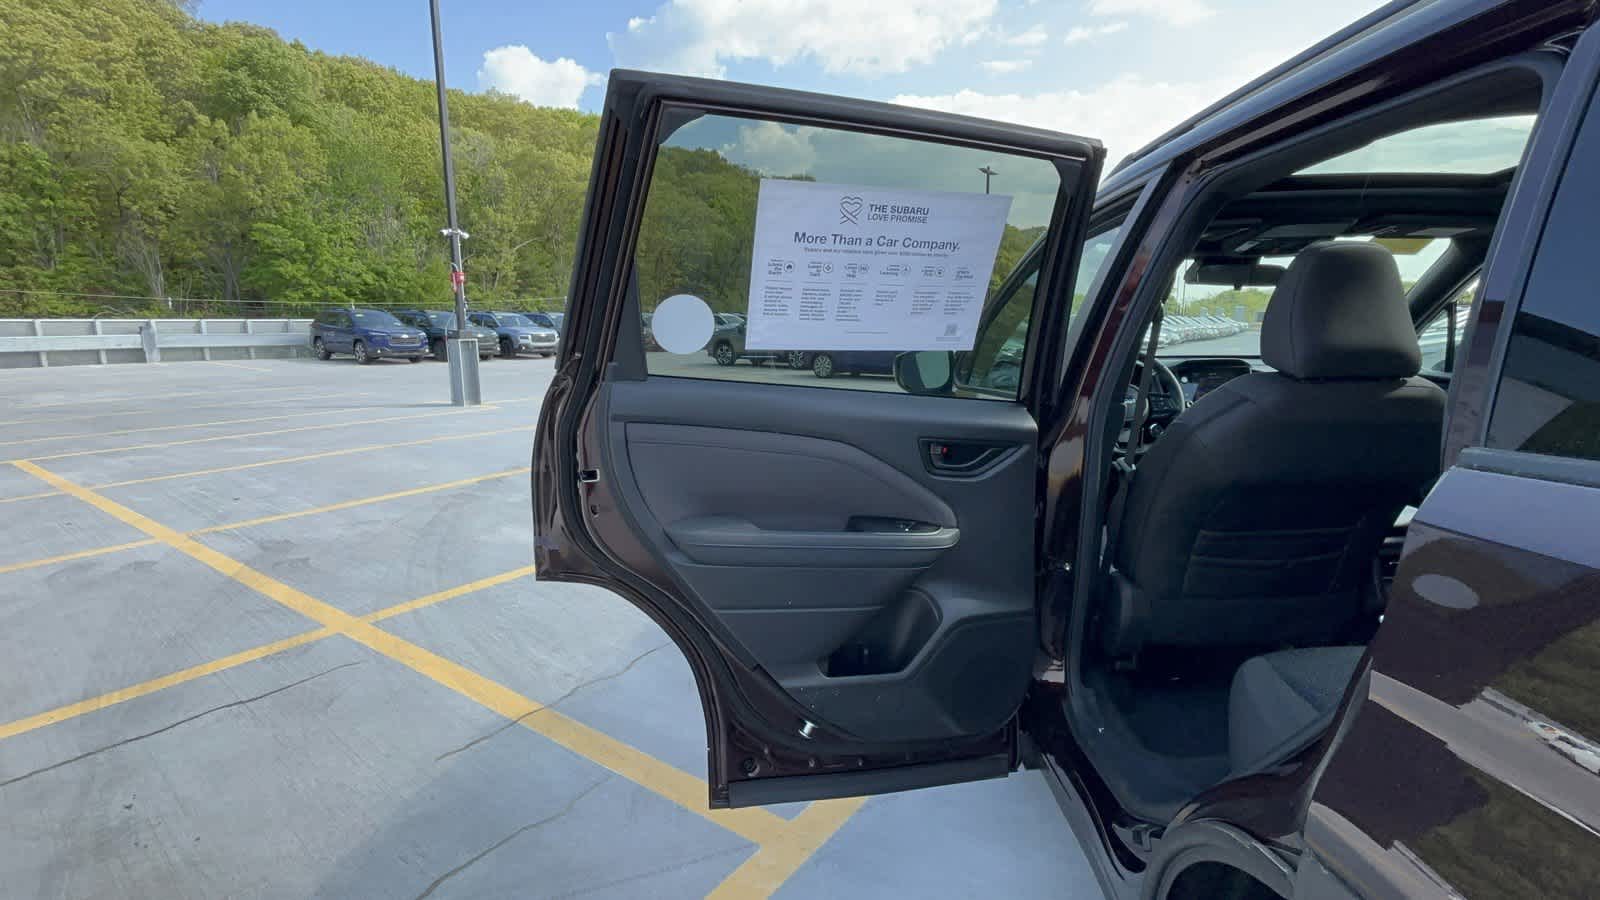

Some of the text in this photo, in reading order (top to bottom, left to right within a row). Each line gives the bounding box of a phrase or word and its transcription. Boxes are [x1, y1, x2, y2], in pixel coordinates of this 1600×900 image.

[869, 203, 930, 216] THE SUBARU
[867, 213, 929, 224] LOVE PROMISE
[793, 231, 828, 245] More
[831, 233, 862, 247] Than
[865, 237, 873, 247] a
[876, 235, 899, 248] Car
[902, 237, 961, 252] Company.
